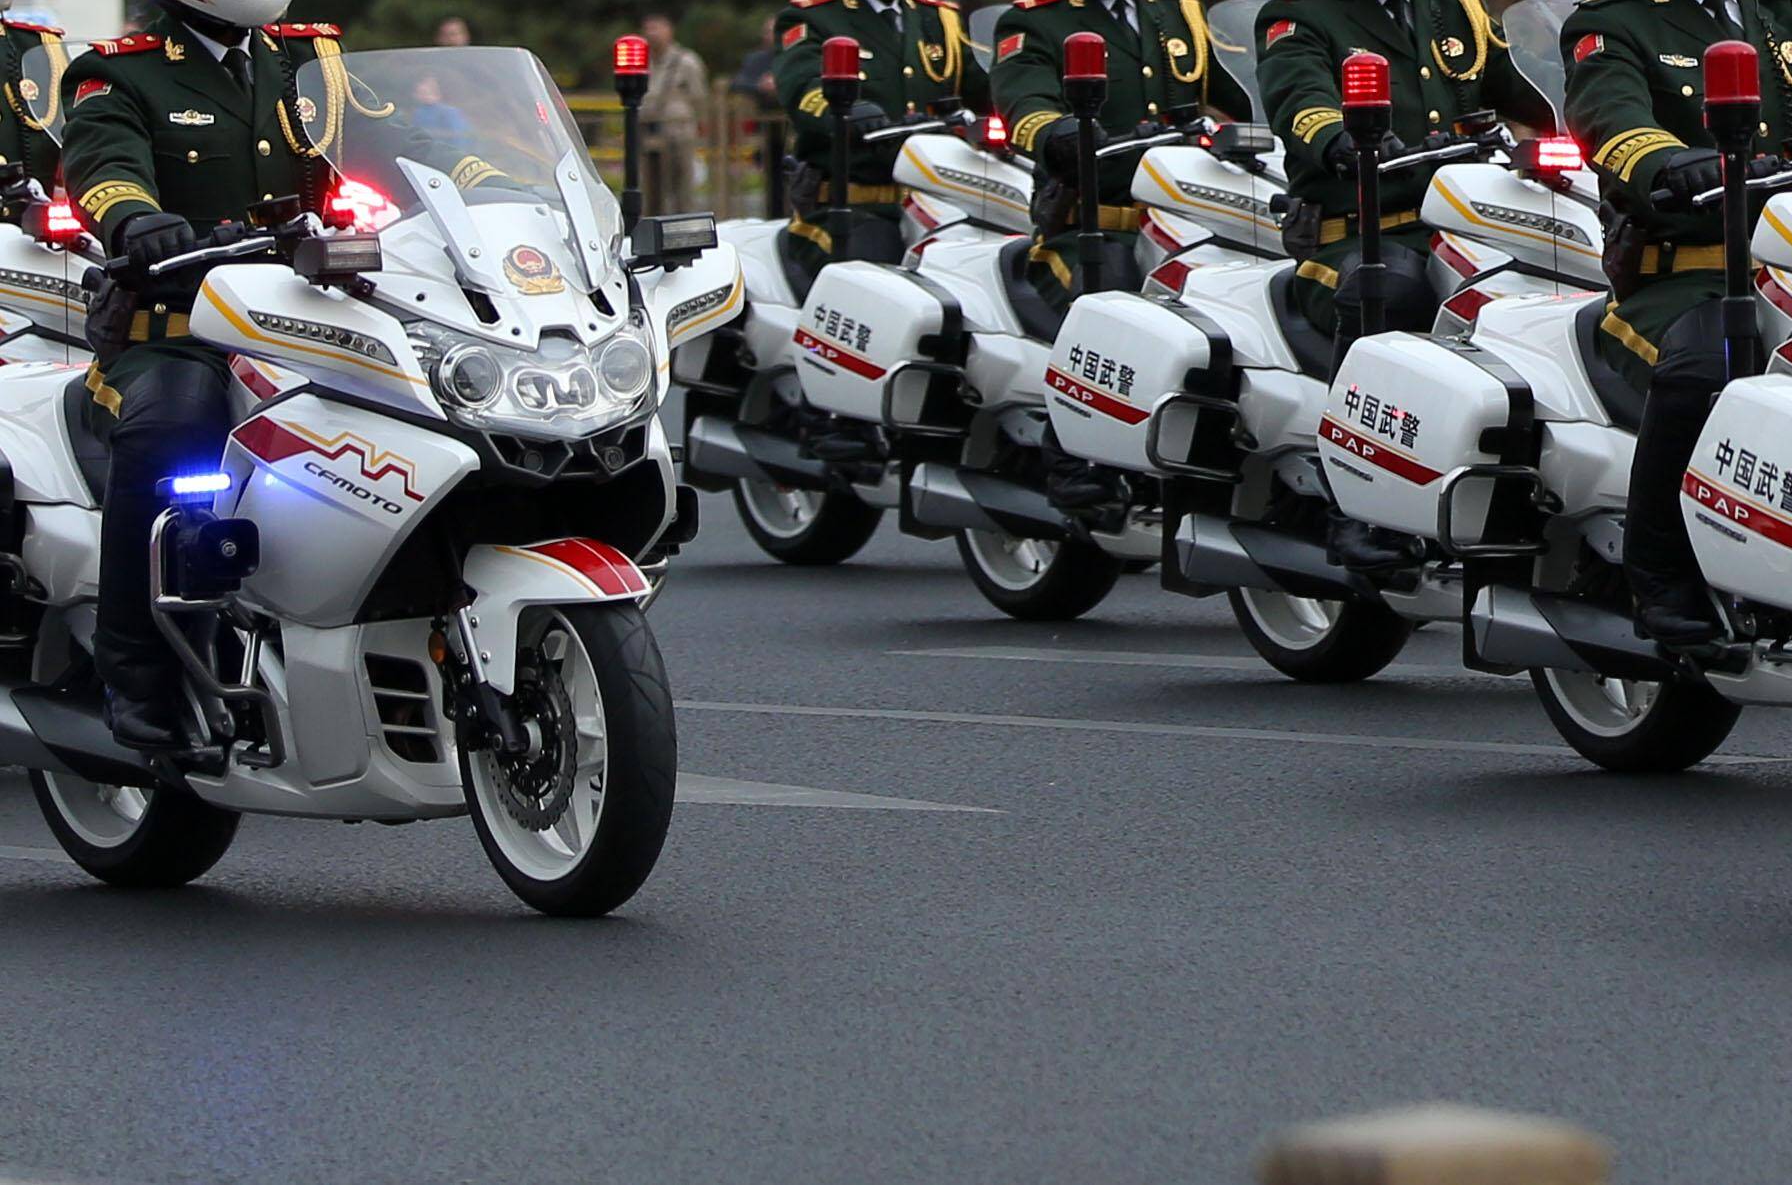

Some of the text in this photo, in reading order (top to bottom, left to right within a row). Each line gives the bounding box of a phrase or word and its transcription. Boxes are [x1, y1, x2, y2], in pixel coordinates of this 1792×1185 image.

[802, 336, 838, 359] PAP
[814, 304, 872, 352] 中国武警
[1054, 376, 1094, 402] PAP
[1069, 343, 1136, 397] 中国武警
[1345, 385, 1420, 449] 中国武警
[1331, 427, 1375, 457] PAP
[303, 461, 402, 514] CFMOTO
[1697, 485, 1749, 520] PAP
